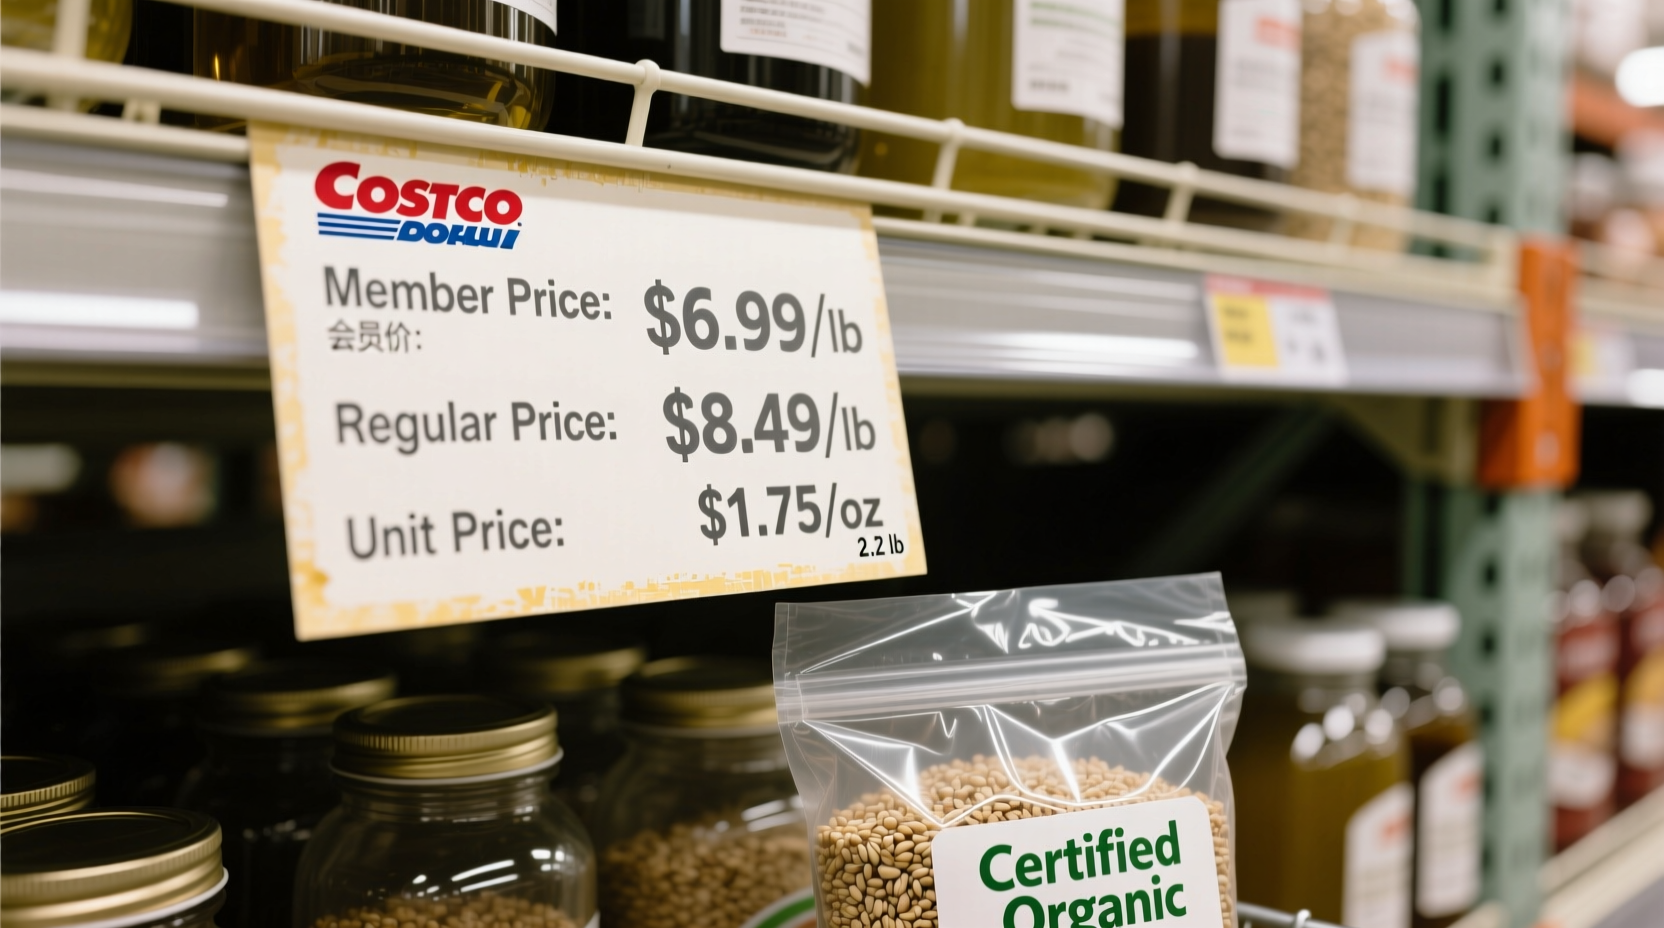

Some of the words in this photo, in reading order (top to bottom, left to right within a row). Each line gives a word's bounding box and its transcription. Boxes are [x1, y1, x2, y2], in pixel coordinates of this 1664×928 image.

[314, 161, 523, 226] COSTCO
[323, 265, 494, 315] Member
[506, 277, 612, 321] Price:
[643, 278, 863, 358] $6.99/lb
[335, 400, 497, 455] Regular
[511, 400, 617, 442] Price:
[662, 386, 876, 462] $8.49/lb
[346, 512, 436, 560] Unit
[451, 508, 565, 553] Price:
[697, 482, 883, 546] $1.75/oz
[857, 535, 885, 558] 2.2
[888, 533, 905, 555] lb
[979, 819, 1181, 892] Certified
[1002, 874, 1187, 928] Organic
